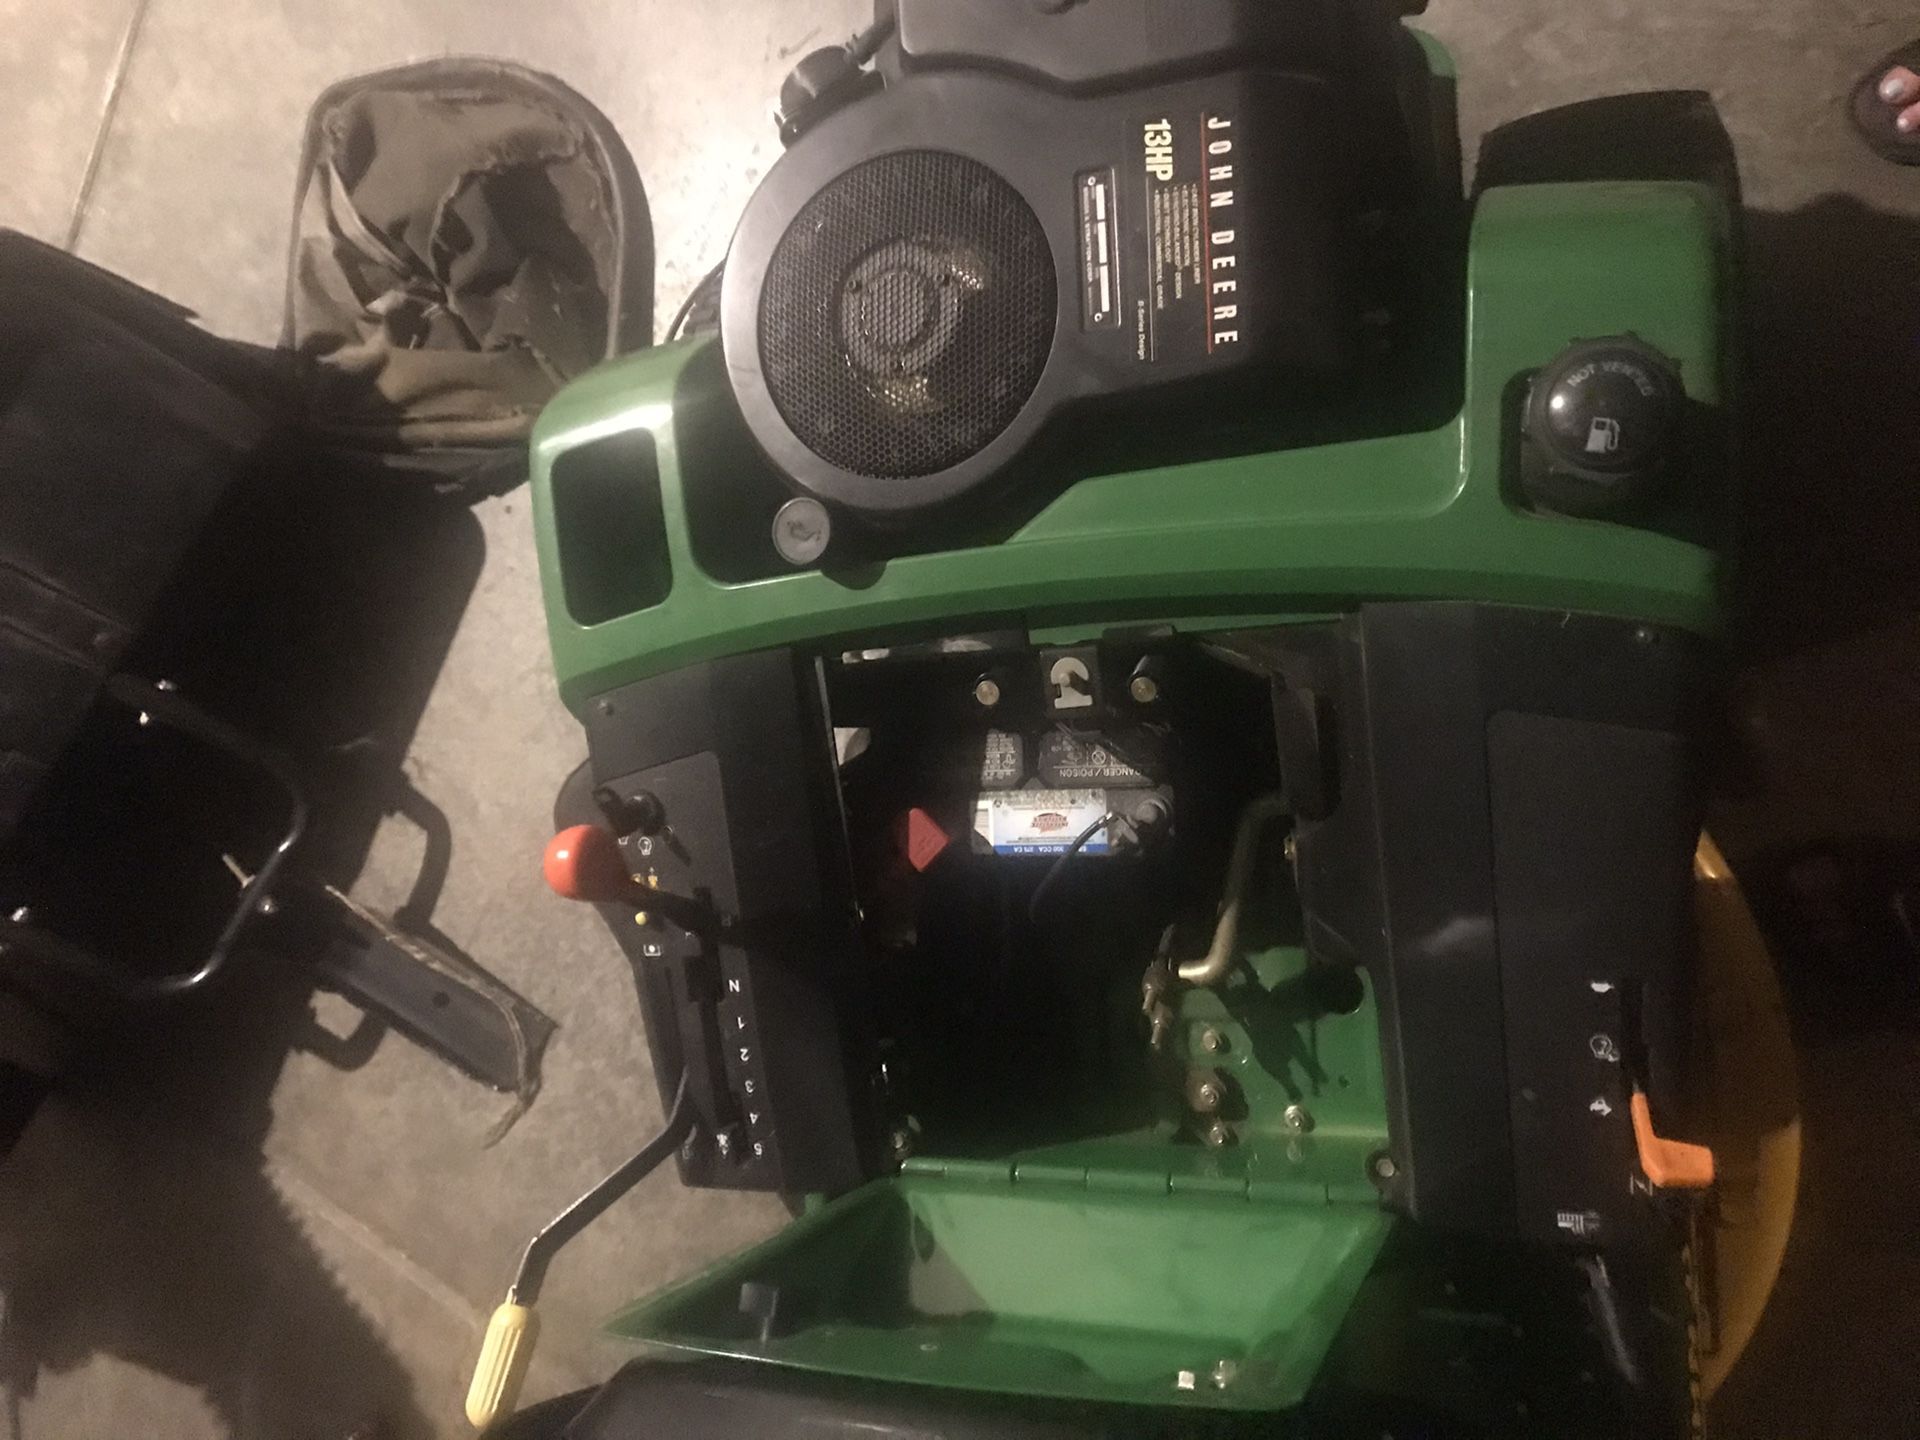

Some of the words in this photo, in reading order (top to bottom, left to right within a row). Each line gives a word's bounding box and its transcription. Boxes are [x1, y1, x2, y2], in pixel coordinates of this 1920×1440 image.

[1144, 119, 1173, 181] 13HP
[1208, 117, 1233, 208] JOHN
[1211, 230, 1238, 345] DEERE
[1138, 334, 1146, 360] Design
[1566, 364, 1595, 387] NOT
[728, 979, 740, 992] N
[737, 1016, 747, 1029] 1
[739, 1048, 750, 1062] 2
[744, 1080, 755, 1094] 3
[749, 1112, 759, 1124] 4
[753, 1142, 763, 1156] 5
